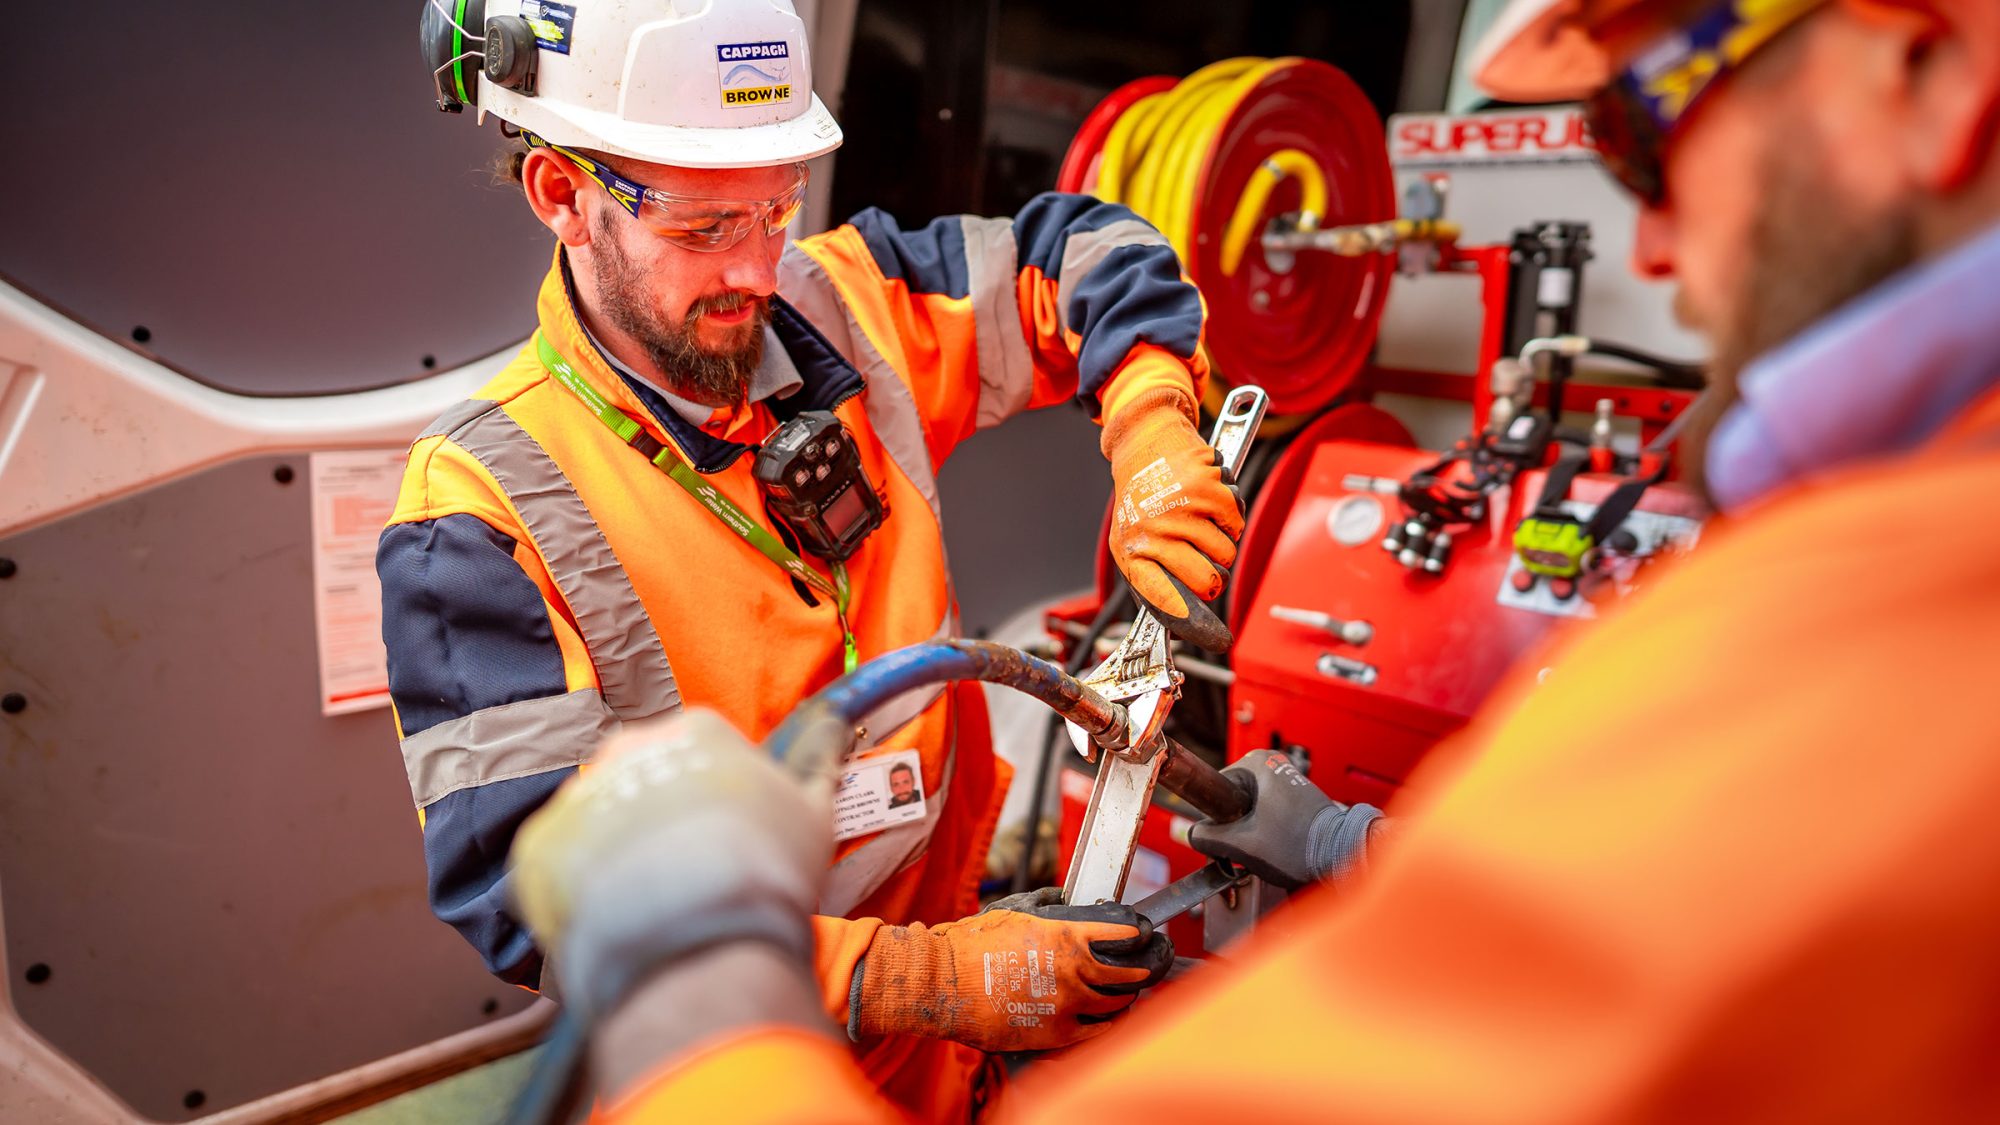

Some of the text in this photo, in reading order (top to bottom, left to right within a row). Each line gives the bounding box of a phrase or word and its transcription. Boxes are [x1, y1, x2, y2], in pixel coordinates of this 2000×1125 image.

[721, 44, 787, 59] CAPPAGH
[726, 87, 790, 103] BROWNE
[704, 497, 723, 516] Water
[1147, 496, 1191, 518] Thermo
[723, 511, 750, 537] Southern
[1045, 949, 1058, 995] Thermo
[988, 996, 1056, 1015] WONDER
